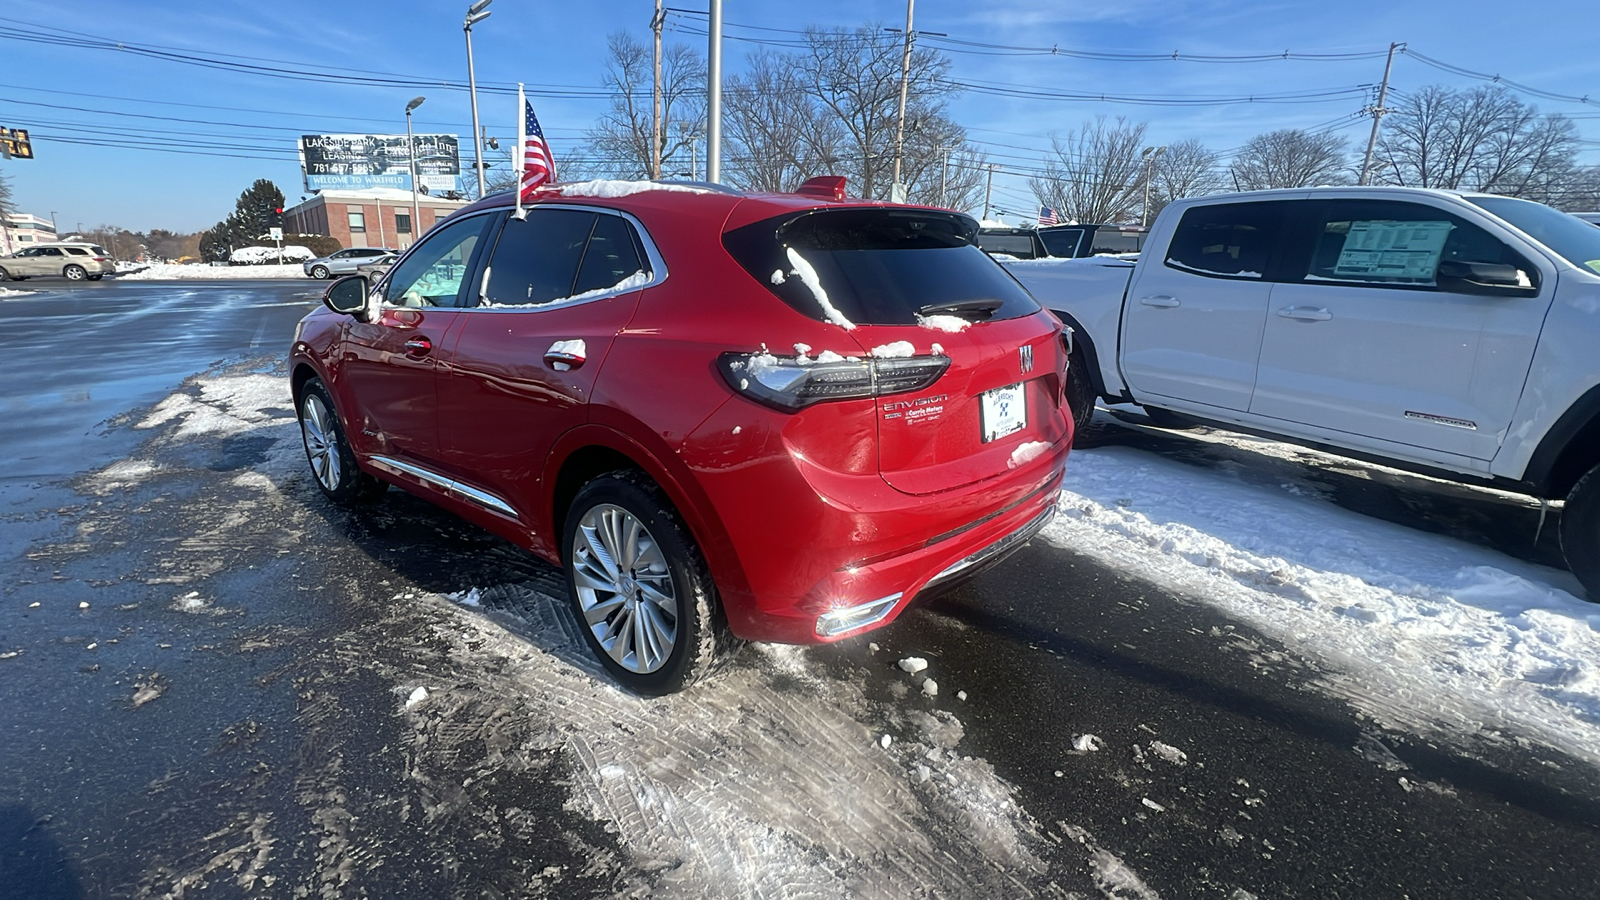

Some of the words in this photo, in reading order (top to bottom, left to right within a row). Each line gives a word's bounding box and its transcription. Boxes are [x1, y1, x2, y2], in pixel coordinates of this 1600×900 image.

[305, 138, 349, 148] LAKESIDE
[351, 137, 376, 147] PARK
[383, 139, 432, 156] Lakeide
[432, 137, 453, 154] Inn
[322, 151, 363, 160] LEASING
[312, 176, 349, 184] WELCOME
[351, 176, 362, 184] TO
[365, 176, 404, 184] WAKEFIELD
[883, 393, 948, 412] ENVISION
[1408, 412, 1474, 428] ELEVATION
